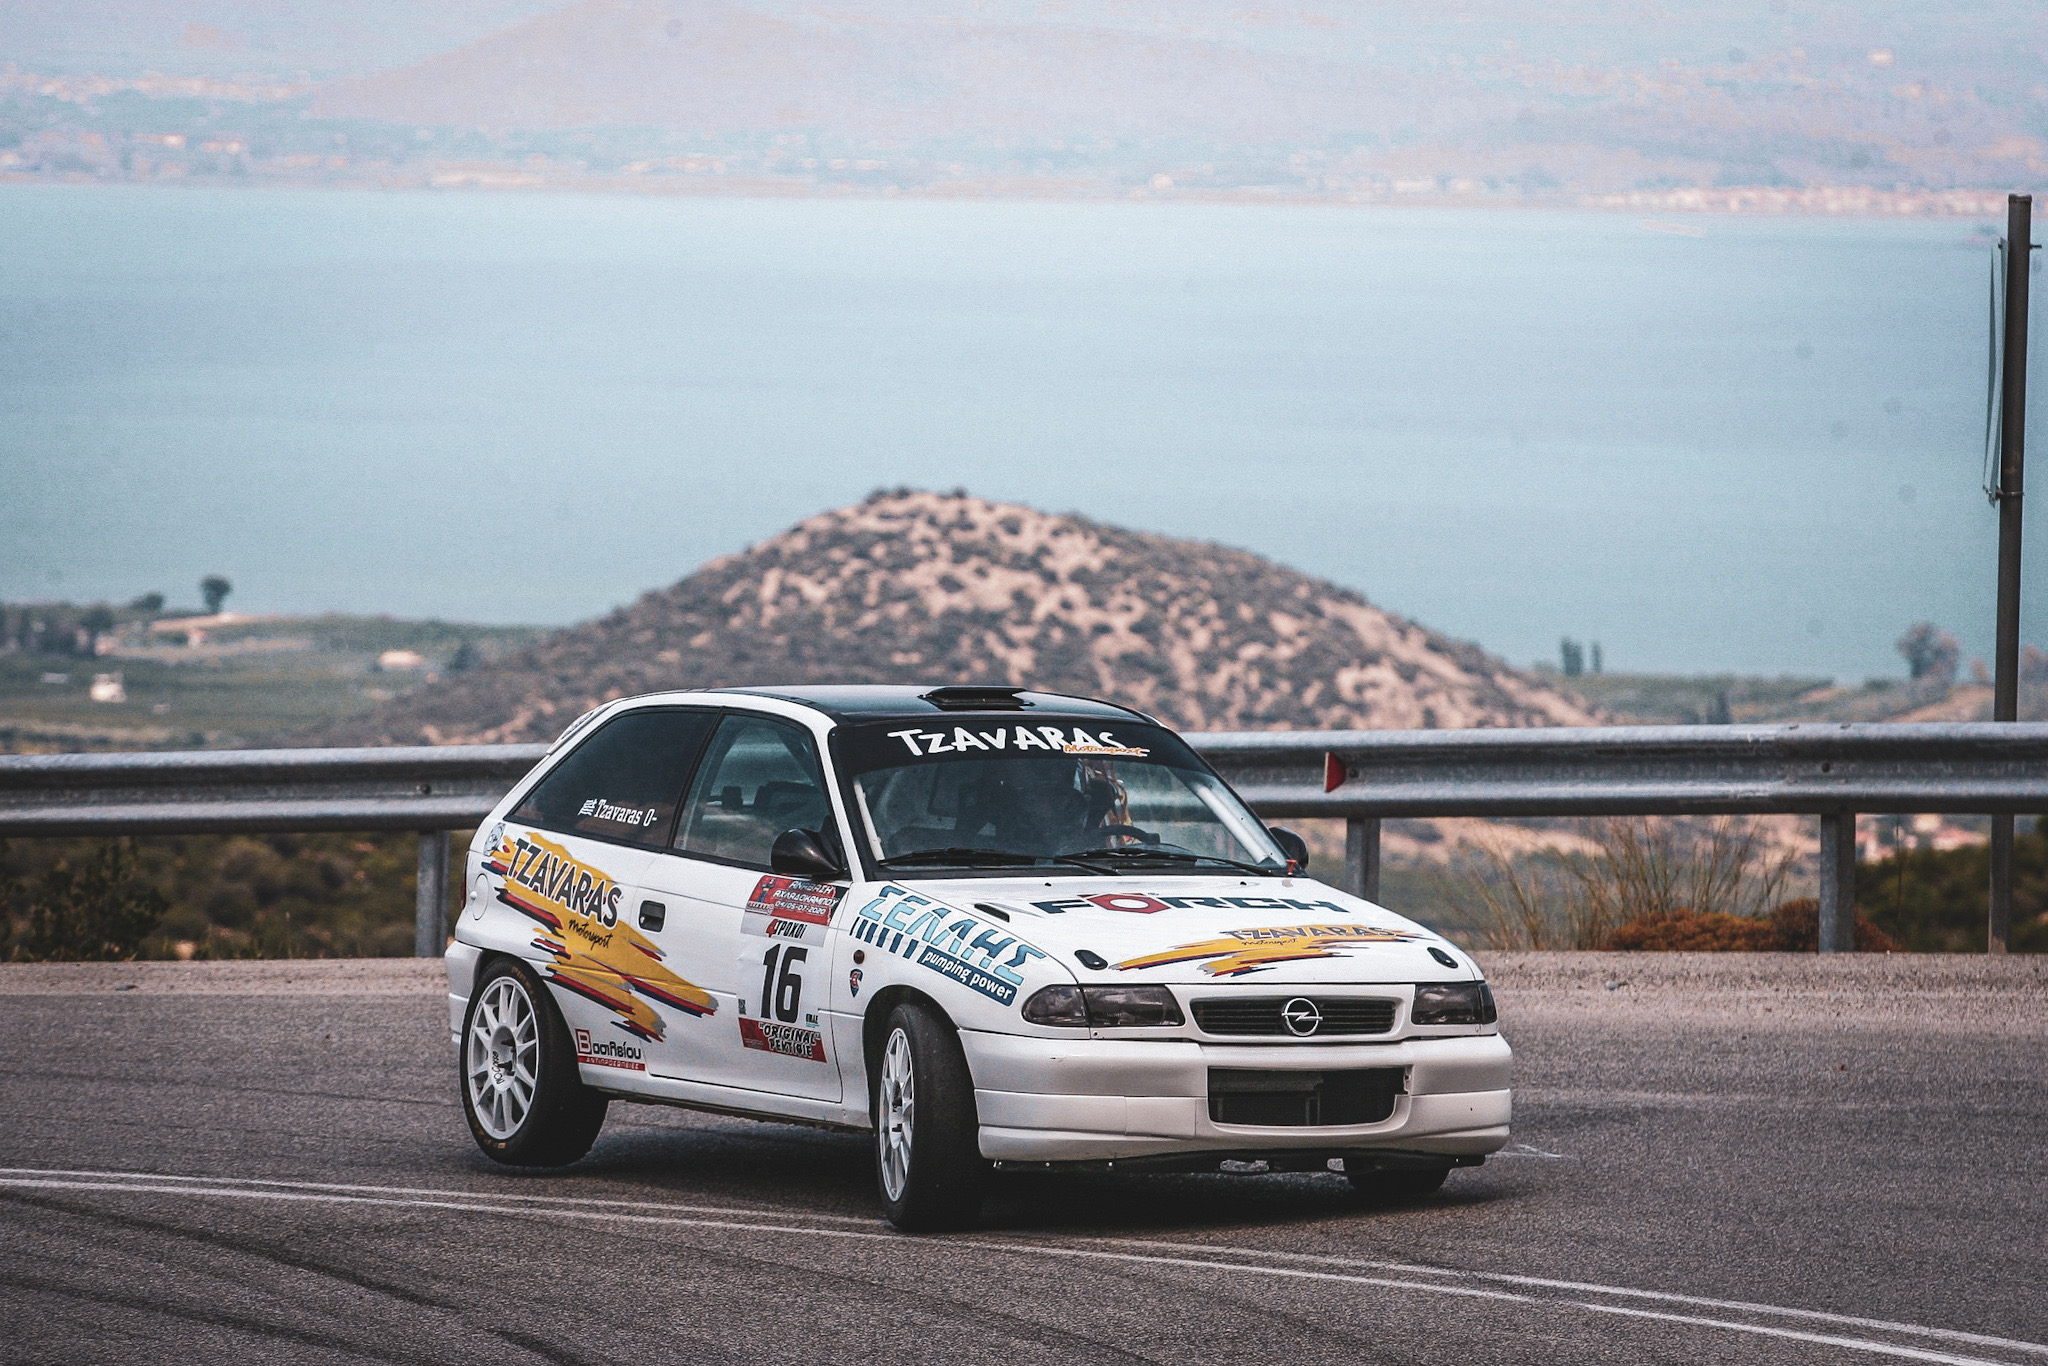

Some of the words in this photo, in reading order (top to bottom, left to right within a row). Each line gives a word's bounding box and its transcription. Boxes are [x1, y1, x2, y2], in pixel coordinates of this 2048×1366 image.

[887, 726, 1128, 756] TZAVARAS
[593, 798, 643, 825] Tzavaras
[507, 837, 623, 929] TZAVARAS
[1219, 926, 1396, 941] TZAVARAS
[760, 943, 808, 1024] 16
[922, 950, 970, 984] pumping
[969, 973, 1013, 1000] power
